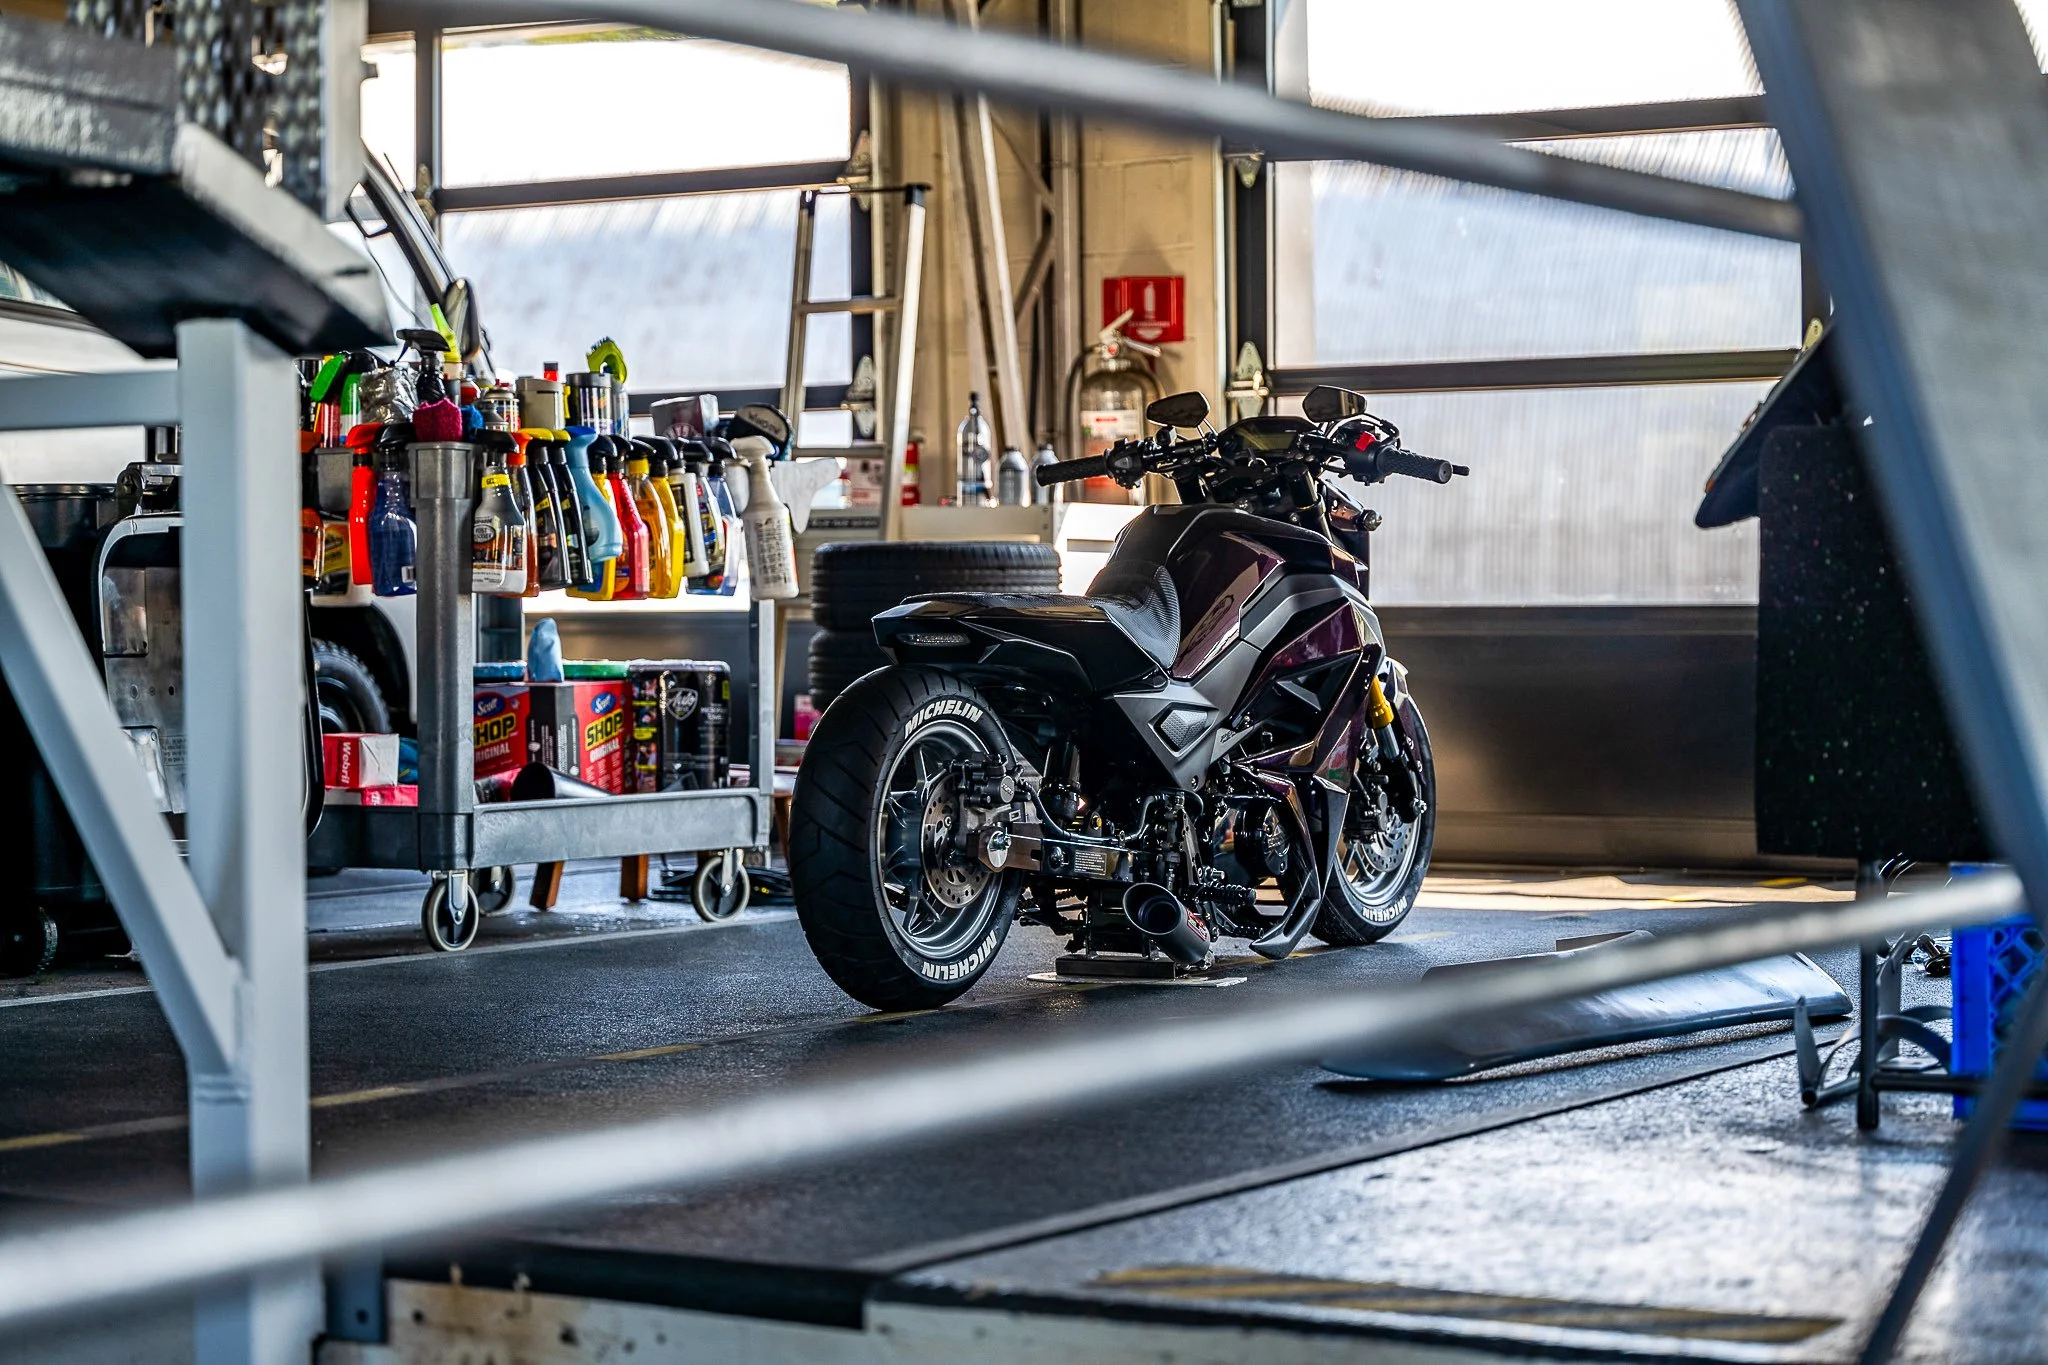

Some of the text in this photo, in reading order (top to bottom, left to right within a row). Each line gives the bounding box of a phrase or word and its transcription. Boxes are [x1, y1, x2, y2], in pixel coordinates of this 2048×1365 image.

[595, 694, 611, 714] Scott
[474, 716, 515, 746] HOP
[587, 712, 623, 747] SHOP
[904, 700, 984, 740] MICHELIN
[341, 742, 351, 784] Webril
[475, 742, 510, 763] RIGINAL
[590, 738, 620, 763] ORIGINAL
[1362, 895, 1408, 922] MICHELIN
[921, 929, 998, 980] MICHELIN
